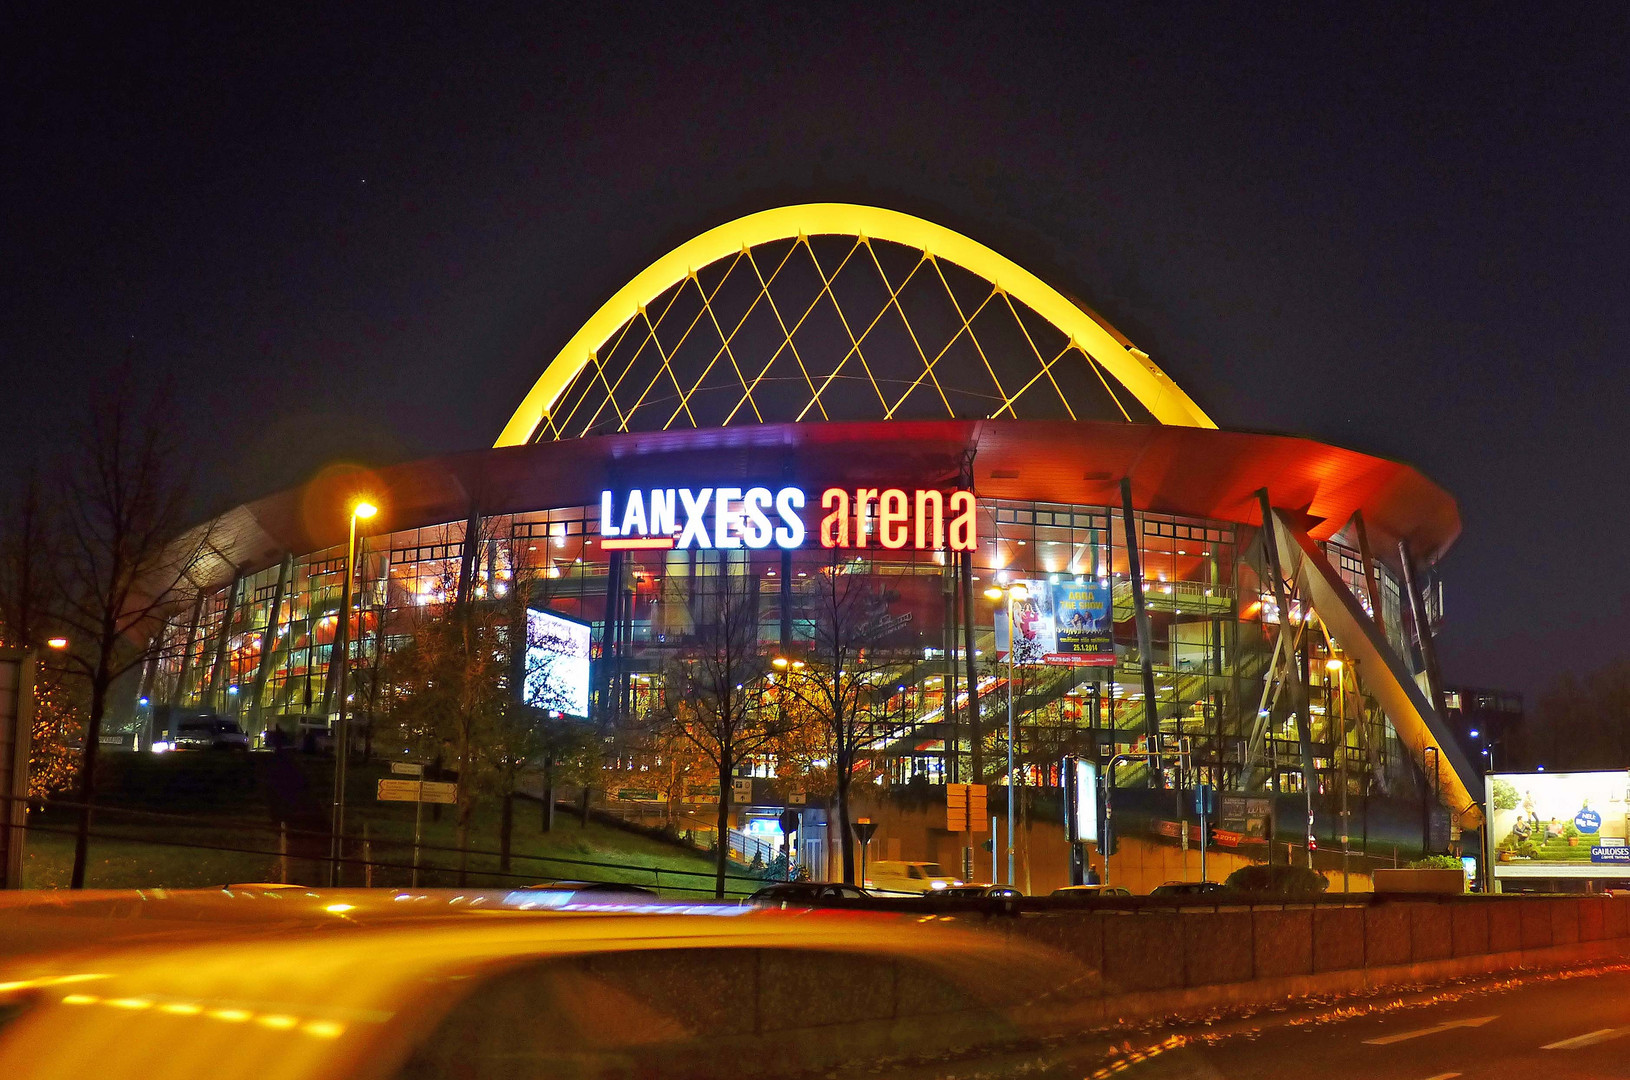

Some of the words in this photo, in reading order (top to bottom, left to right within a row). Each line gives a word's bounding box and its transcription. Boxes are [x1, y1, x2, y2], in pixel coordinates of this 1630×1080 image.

[600, 487, 806, 550] LANXESS
[820, 487, 978, 551] arena
[1069, 591, 1095, 600] ABBA
[1060, 601, 1076, 609] THE
[1079, 601, 1103, 609] SHOW
[1591, 847, 1629, 856] GAULOISES
